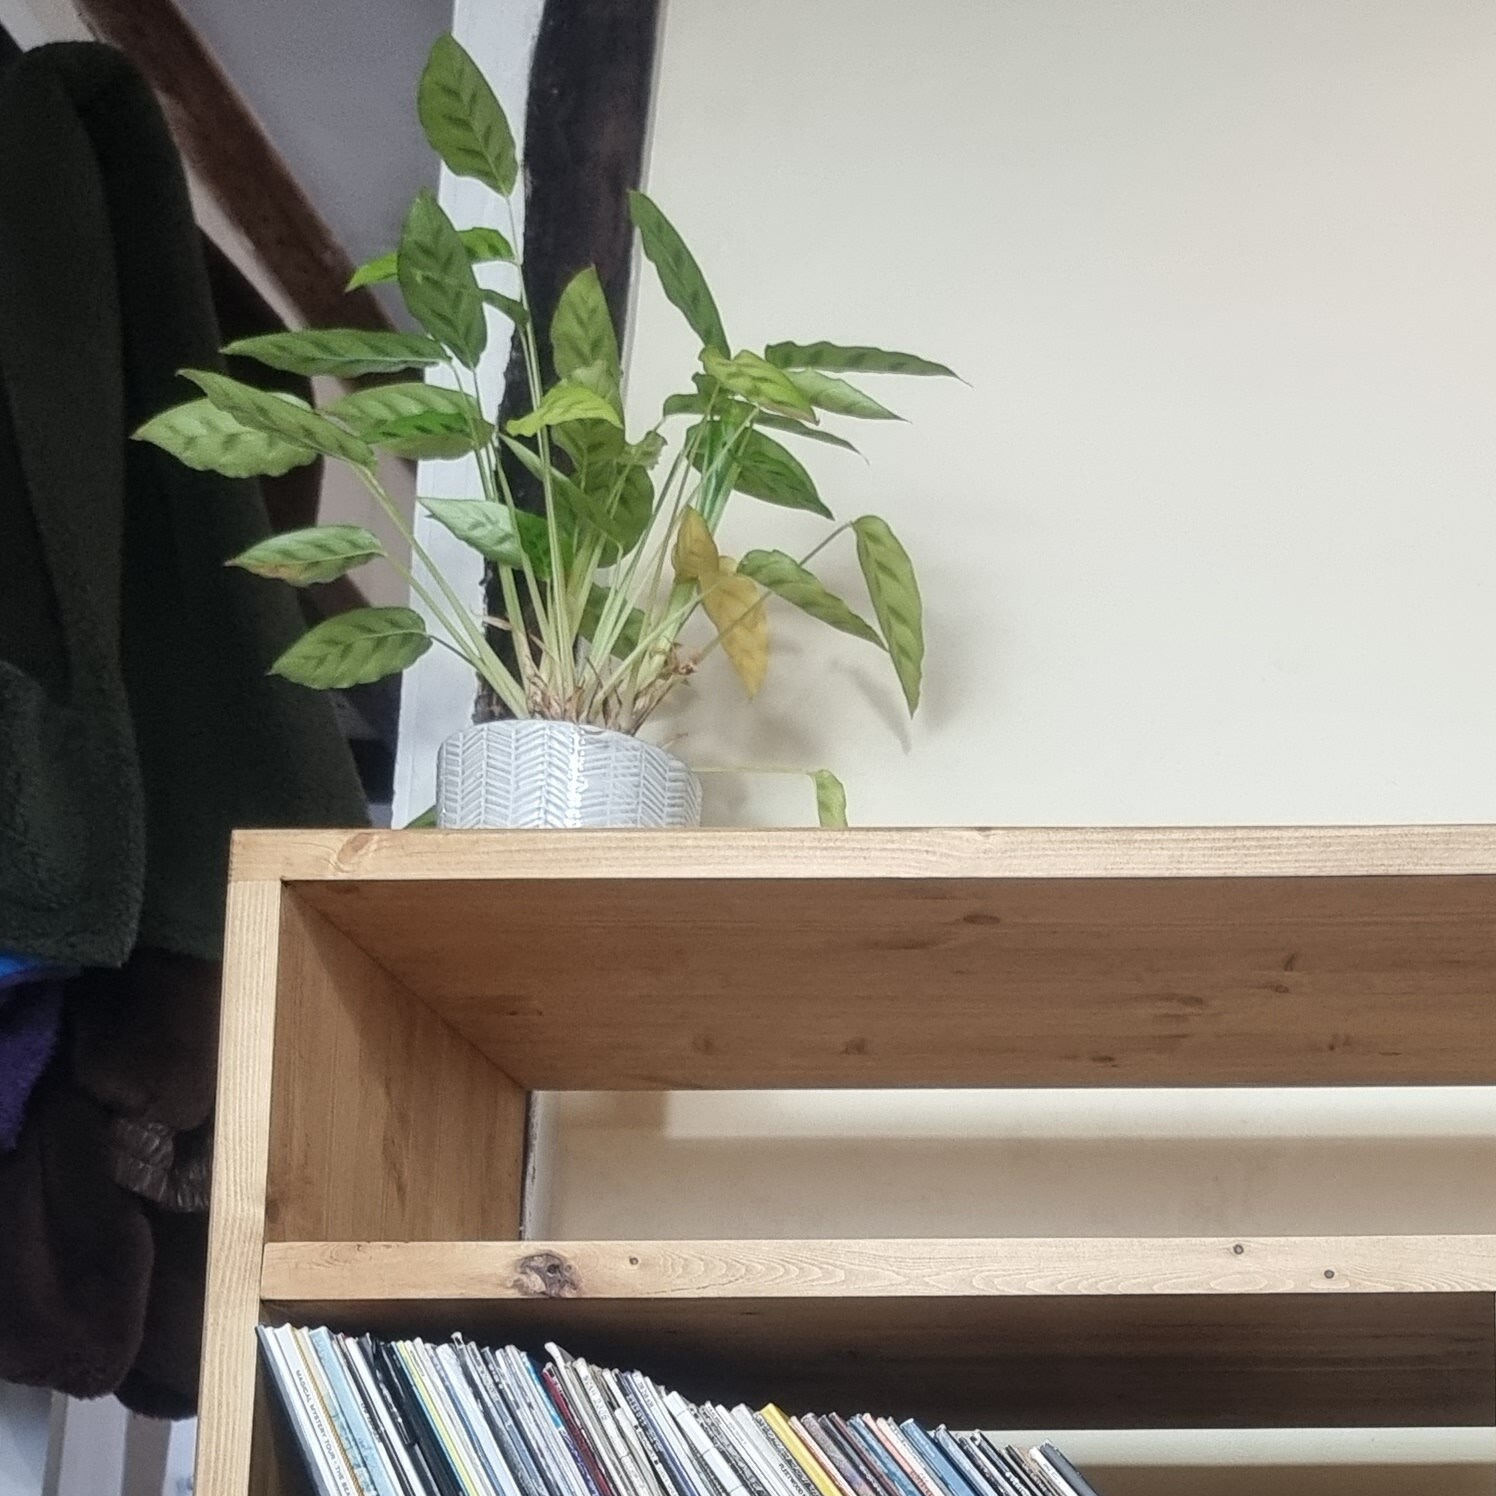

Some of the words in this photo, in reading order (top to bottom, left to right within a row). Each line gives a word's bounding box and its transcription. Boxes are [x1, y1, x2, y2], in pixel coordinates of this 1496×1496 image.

[294, 1369, 312, 1403] MAGICAL
[309, 1403, 327, 1438] MYSTERY
[777, 1462, 804, 1494] FLEETWOOD
